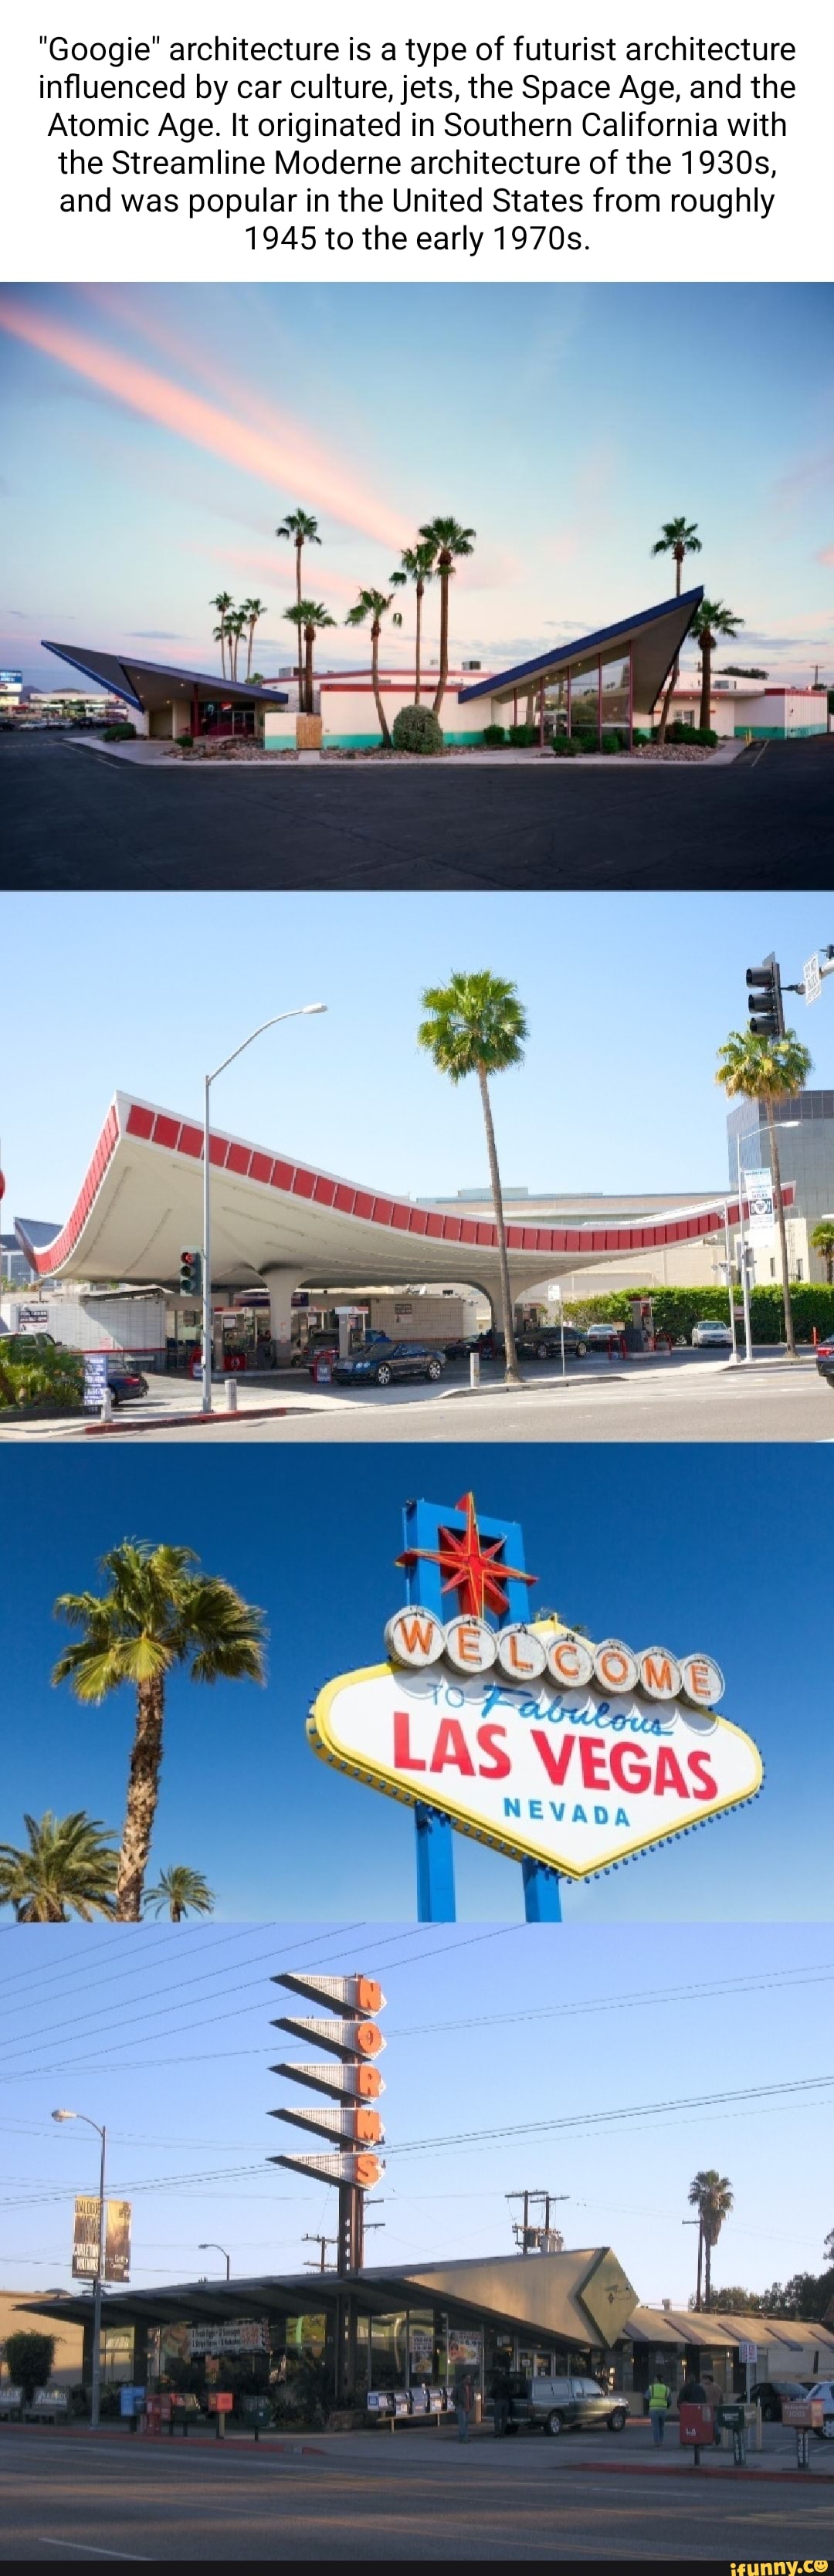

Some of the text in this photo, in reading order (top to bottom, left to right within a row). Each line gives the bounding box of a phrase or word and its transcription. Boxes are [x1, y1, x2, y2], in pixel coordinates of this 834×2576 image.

[400, 1618, 712, 1696] WELCOME
[427, 1683, 673, 1737] TO Fabulous
[392, 1711, 718, 1801] LAS VEGAS
[503, 1797, 631, 1827] NEVADA
[356, 1977, 381, 2184] NORMS
